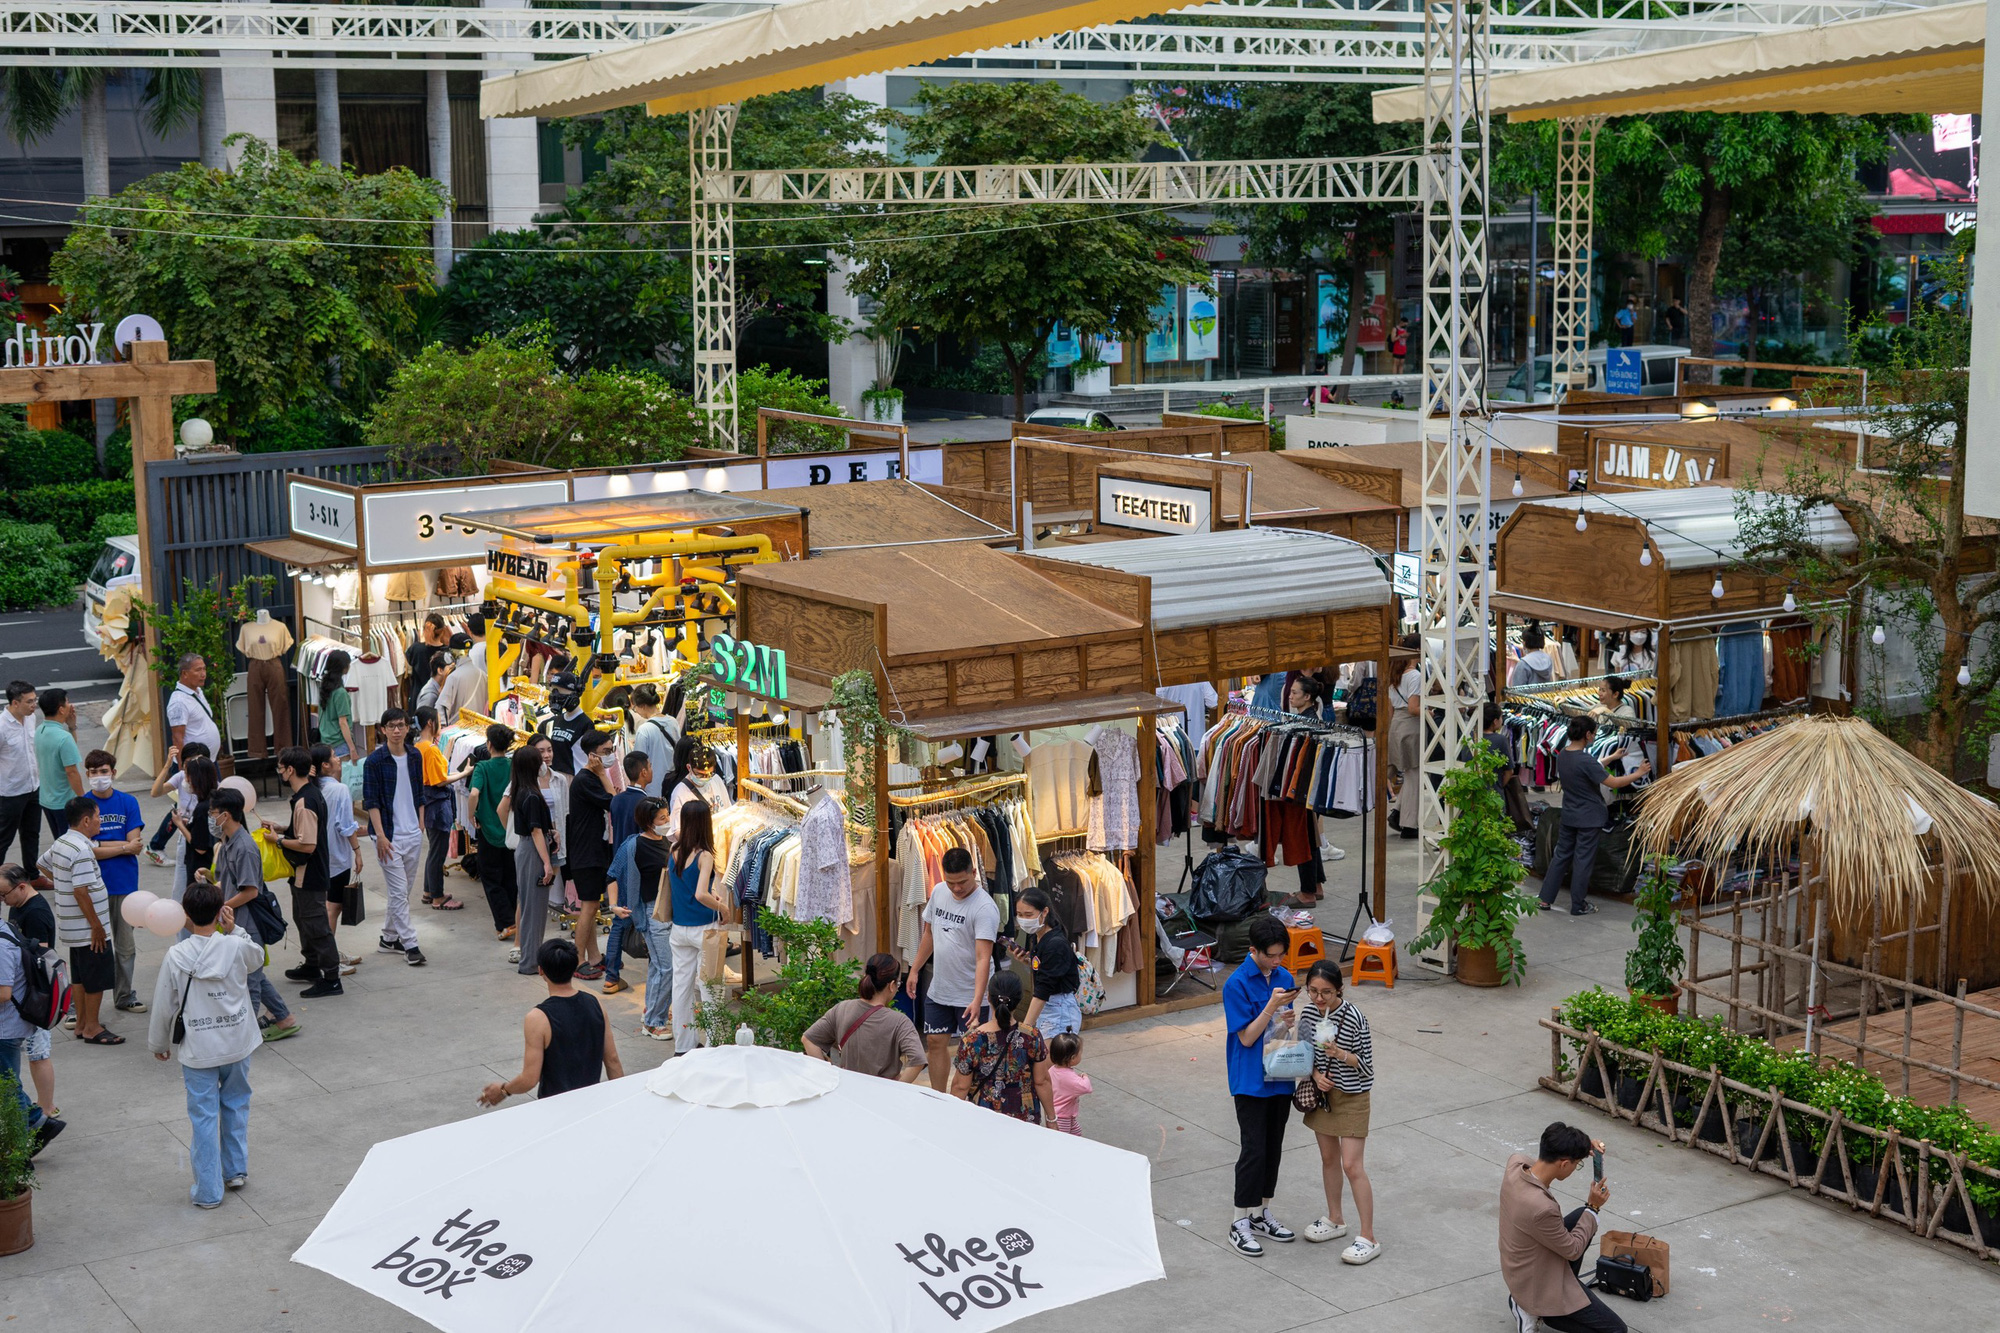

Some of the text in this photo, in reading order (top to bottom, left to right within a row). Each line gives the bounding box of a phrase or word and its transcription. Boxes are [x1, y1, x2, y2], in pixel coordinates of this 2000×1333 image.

[309, 502, 339, 528] 3-SIX
[1111, 493, 1192, 524] TEE4TEEN
[487, 549, 548, 584] HYBEAR
[709, 633, 788, 699] S2M
[432, 1208, 507, 1266] the
[1000, 1232, 1022, 1245] con
[1005, 1238, 1031, 1251] cept
[504, 1257, 526, 1268] con
[895, 1233, 999, 1277] the
[496, 1263, 520, 1277] cept
